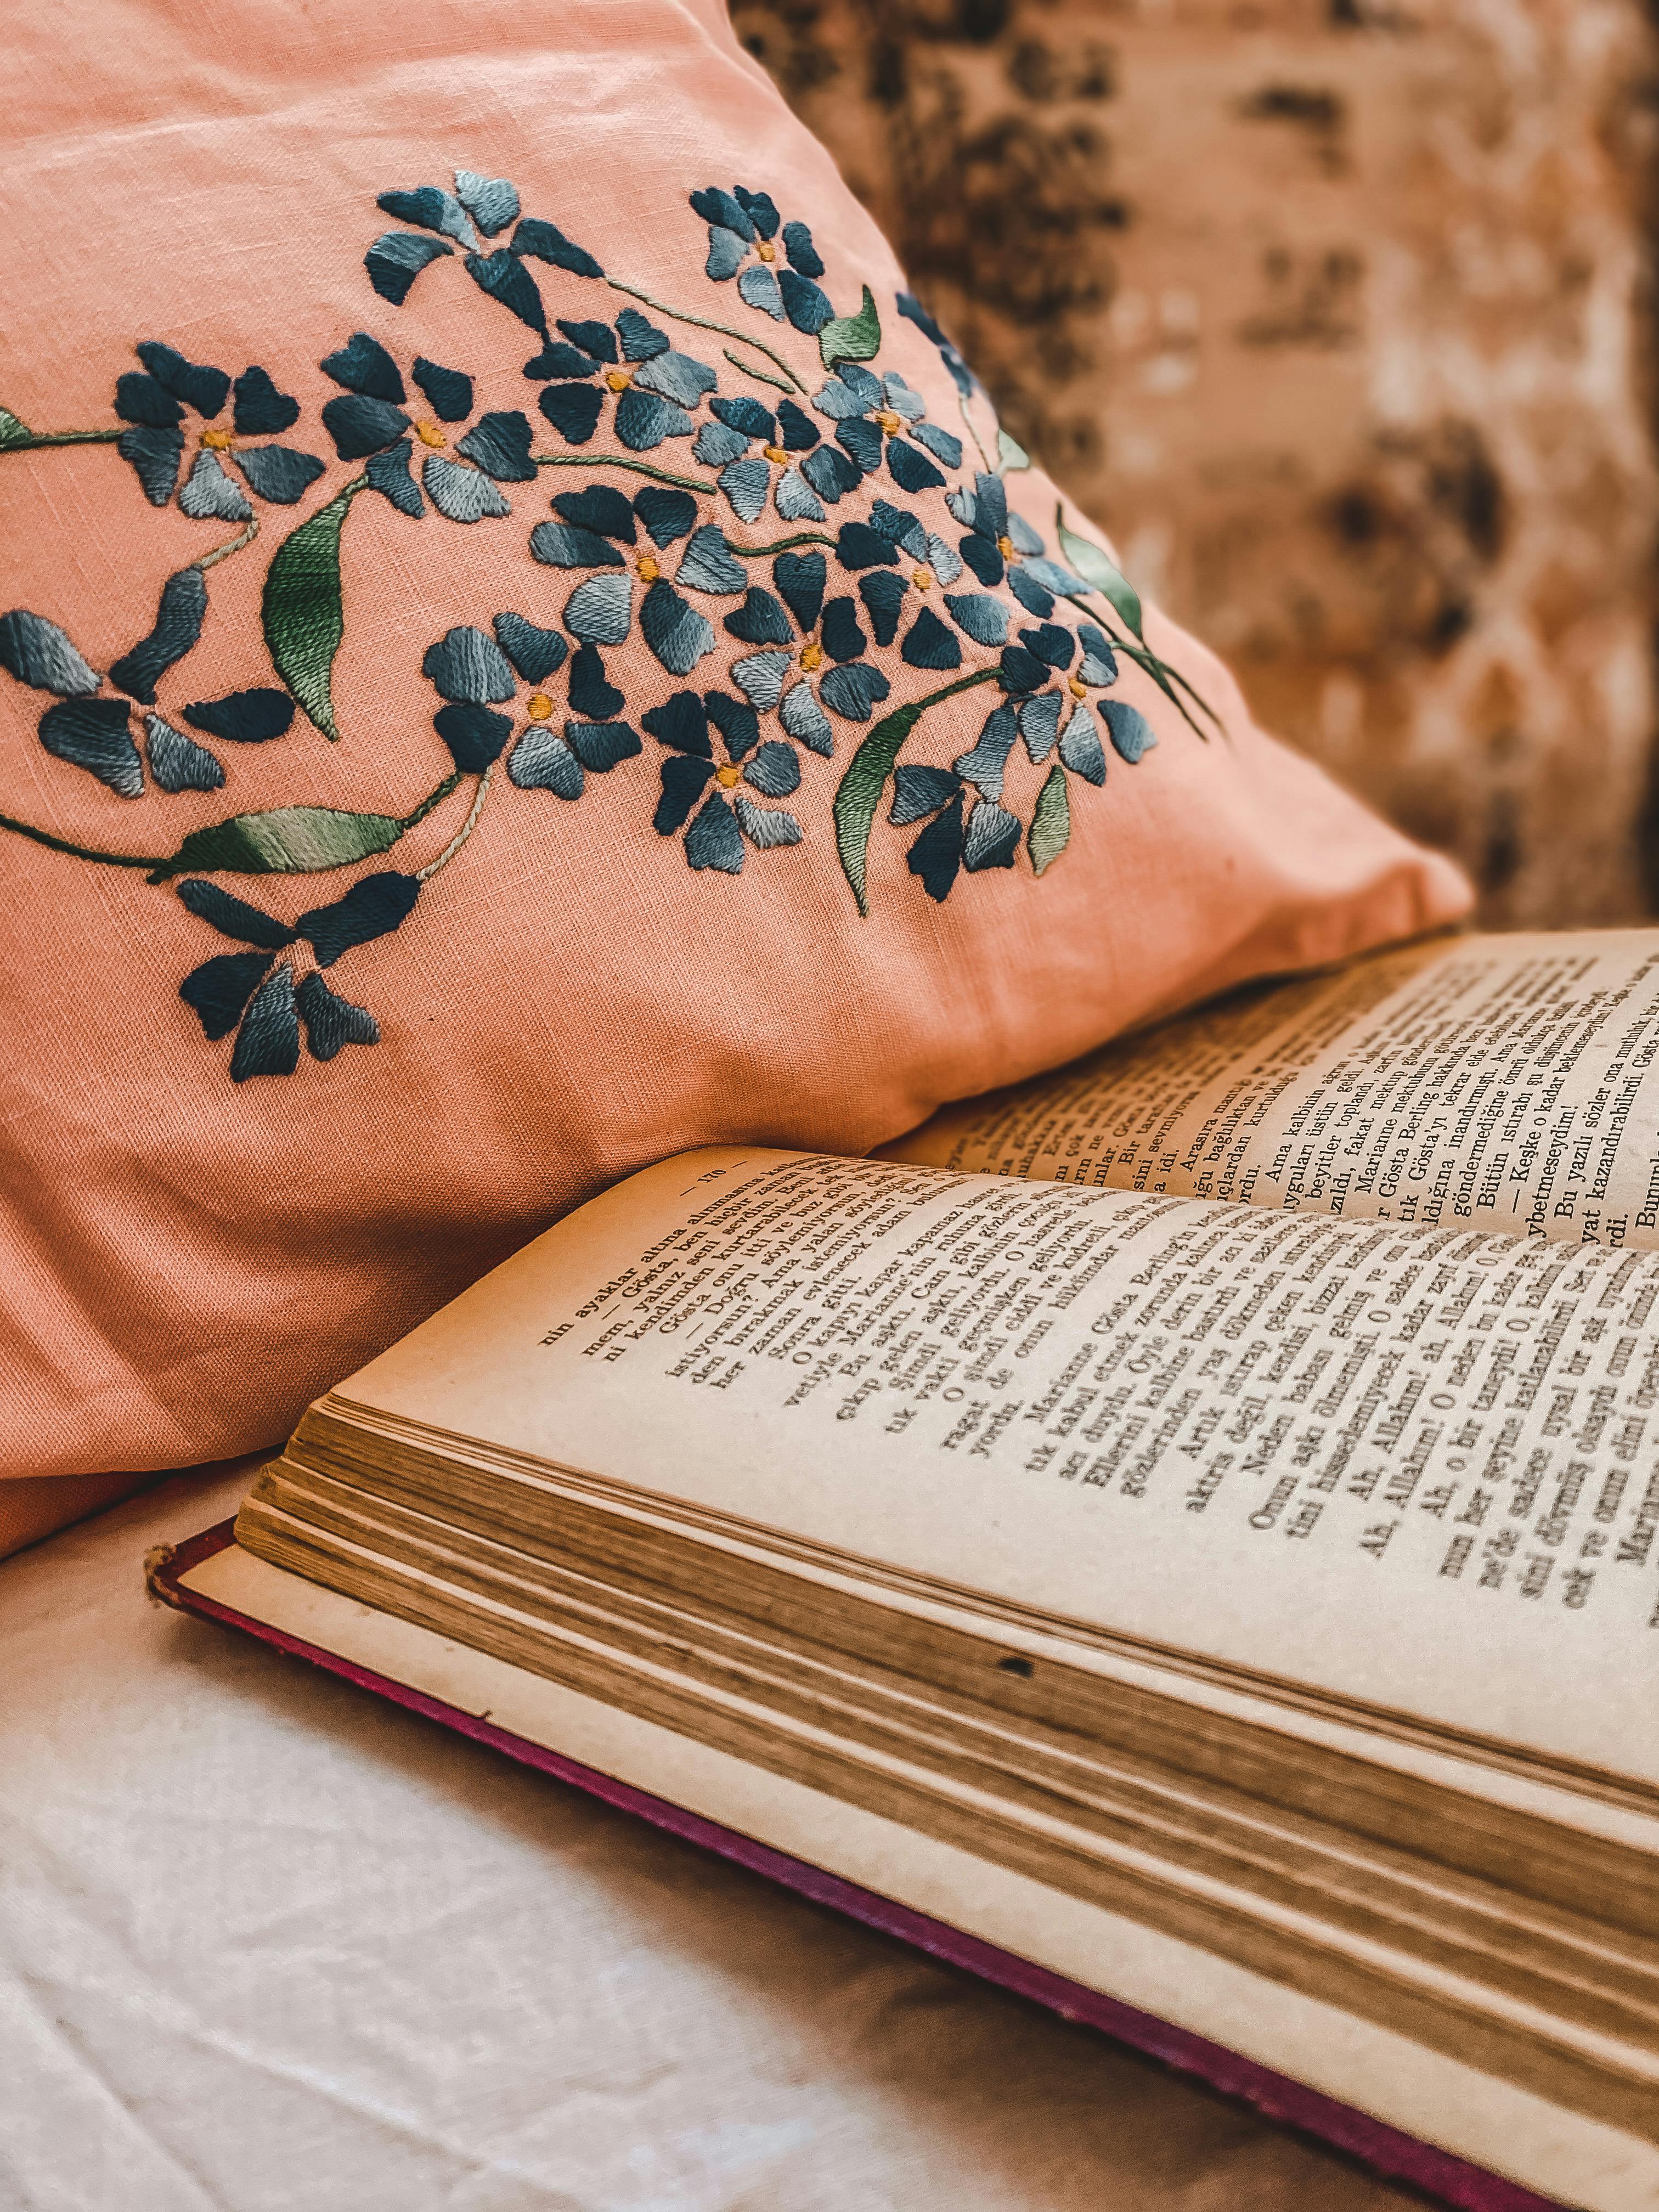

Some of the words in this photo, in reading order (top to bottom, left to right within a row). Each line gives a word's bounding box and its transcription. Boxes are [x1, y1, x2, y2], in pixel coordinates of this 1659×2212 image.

[1465, 1049, 1489, 1067] elde
[1526, 1073, 1544, 1087] şu
[1534, 1022, 1580, 1068] düşüncenin
[1204, 1095, 1257, 1162] bağlılıktan
[1305, 1101, 1339, 1137] üstün
[1336, 1068, 1365, 1093] geldi.
[1344, 1117, 1375, 1156] fakat
[1370, 1069, 1408, 1110] mektup
[1354, 1118, 1397, 1195] Marianne
[1391, 1057, 1441, 1113] mektubunu
[1378, 1147, 1410, 1198] Gösta
[1397, 1091, 1440, 1141] Berling
[1425, 1046, 1472, 1087] hakkında
[1438, 1071, 1472, 1107] tekrar
[1443, 1069, 1499, 1149] inandırmıştı.
[1491, 1042, 1518, 1063] Ama
[1501, 1092, 1533, 1143] ıstırabı
[1534, 1076, 1566, 1113] kadar
[1534, 1117, 1547, 1126] o
[697, 1170, 726, 1183] 170
[1088, 1135, 1104, 1150] ne
[1117, 1141, 1141, 1165] Bir
[1131, 1159, 1154, 1192] sini
[1156, 1149, 1180, 1173] idi.
[1180, 1119, 1218, 1173] Arasıra
[1265, 1144, 1293, 1183] Ama
[1282, 1088, 1326, 1137] kalbinin
[1304, 1135, 1342, 1199] beyitler
[1334, 1079, 1379, 1127] toplandı,
[1408, 1116, 1447, 1181] Gösta'yı
[1451, 1090, 1509, 1218] göndermediğine
[1498, 1058, 1530, 1085] ömrü
[1509, 1131, 1542, 1183] Keşke
[1525, 1105, 1579, 1239] ybetmeseydim!
[1554, 1190, 1578, 1220] Bu
[1567, 1135, 1593, 1183] yazılı
[1582, 1087, 1611, 1128] sözler
[1603, 1062, 1624, 1082] ona
[1585, 1073, 1645, 1200] kazandırabilirdi.
[1397, 1194, 1420, 1222] tık
[1476, 1152, 1510, 1210] Bütün
[537, 1322, 574, 1346] nin
[575, 1267, 638, 1318] ayaklar
[640, 1228, 688, 1263] altına
[687, 1177, 766, 1226] alınmasına
[580, 1320, 635, 1356] mem,
[633, 1271, 686, 1313] yalnız
[686, 1239, 722, 1266] seni
[722, 1199, 779, 1235] sevdim.
[775, 1176, 816, 1194] Beni
[601, 1346, 627, 1362] ni
[624, 1267, 715, 1340] kendimden
[710, 1188, 820, 1261] kurtarabilecek
[816, 1173, 845, 1187] tek
[622, 1257, 679, 1297] Gösta,
[672, 1230, 708, 1251] ben
[704, 1198, 753, 1227] hiçbir
[753, 1172, 802, 1196] zaman
[659, 1294, 712, 1334] Gösta
[712, 1263, 745, 1288] onu
[740, 1238, 773, 1257] itti
[771, 1221, 793, 1234] ve
[788, 1200, 823, 1218] buz
[822, 1182, 854, 1200] gibi
[847, 1172, 876, 1182] bir
[702, 1272, 760, 1316] Doğru
[761, 1192, 866, 1266] söylemiyorsun,
[1028, 1220, 1093, 1273] geliyordu.
[1581, 1208, 1602, 1245] yat
[664, 1295, 759, 1378] istiyorsun?
[761, 1258, 802, 1289] Ama
[800, 1221, 845, 1254] yalan
[690, 1355, 727, 1384] den
[723, 1278, 804, 1346] bırakmak
[802, 1198, 902, 1272] istemiyorsun?
[710, 1361, 747, 1390] her
[748, 1307, 804, 1357] zaman
[803, 1240, 873, 1301] evlenecek
[872, 1210, 912, 1237] adam
[768, 1316, 822, 1359] Sonra
[822, 1276, 864, 1310] gitti.
[792, 1351, 812, 1364] O
[805, 1302, 864, 1347] kapıyı
[855, 1260, 904, 1297] kapar
[897, 1210, 964, 1256] kapamaz
[834, 1257, 937, 1346] Marianne'nin
[935, 1214, 986, 1251] ruhuna
[836, 1353, 872, 1376] Bu
[871, 1307, 916, 1347] aşktı.
[911, 1269, 951, 1299] Can
[950, 1241, 981, 1265] gibi
[879, 1330, 923, 1372] gelen
[957, 1232, 1020, 1278] kalbinin
[940, 1268, 1010, 1337] geliyordu.
[1005, 1251, 1024, 1261] O
[1159, 1293, 1204, 1330] derin
[1190, 1266, 1223, 1286] bir
[1365, 1268, 1387, 1282] ve
[942, 1386, 966, 1403] O
[1005, 1295, 1043, 1331] ciddi
[1039, 1274, 1062, 1289] ve
[987, 1368, 1014, 1390] de
[1013, 1319, 1054, 1358] onun
[1023, 1342, 1098, 1425] Marianne
[1091, 1294, 1139, 1335] Gösta
[1045, 1386, 1101, 1438] kabul
[1093, 1332, 1141, 1382] etmek
[1134, 1273, 1188, 1328] zorunda
[1135, 1346, 1195, 1409] kalbine
[1233, 1266, 1256, 1282] ve
[1389, 1299, 1434, 1342] kadar
[1247, 1474, 1300, 1530] Onun
[1368, 1310, 1391, 1322] O
[1429, 1393, 1456, 1410] O
[1446, 1456, 1466, 1471] o
